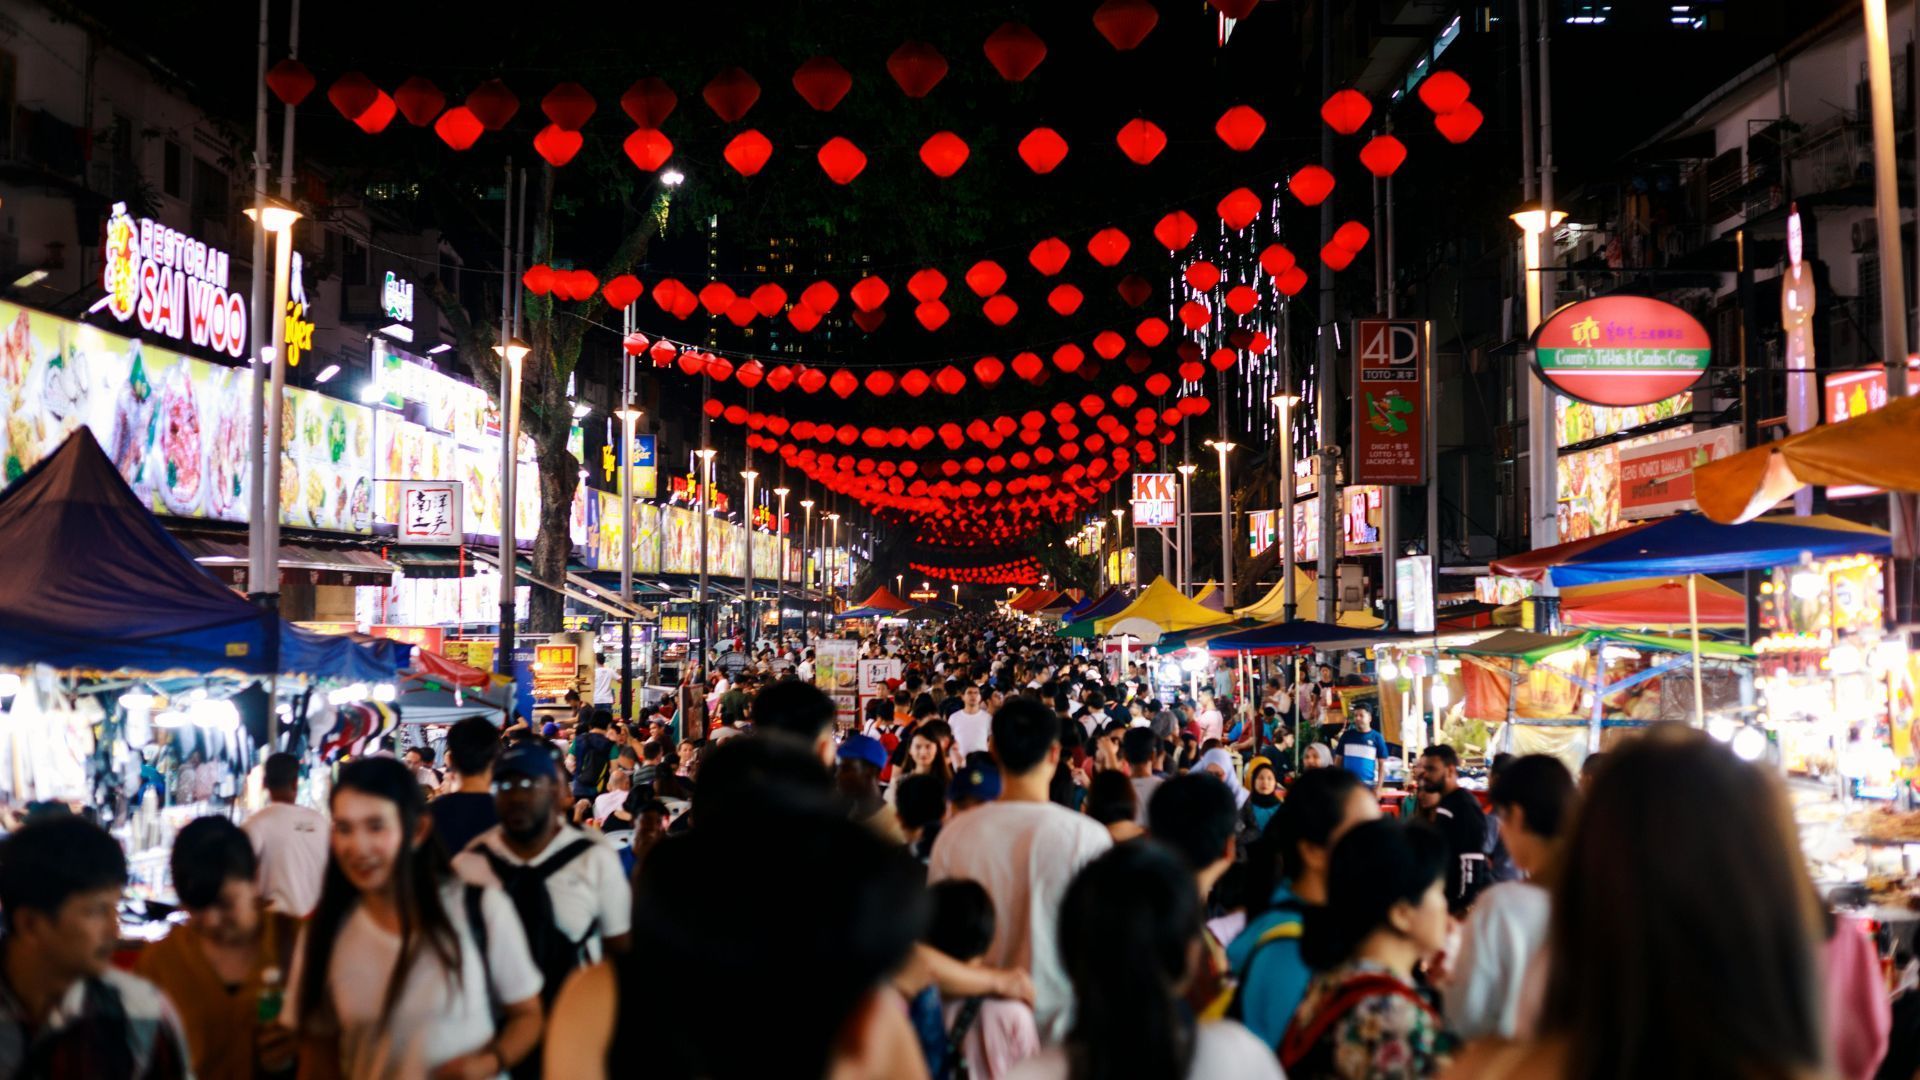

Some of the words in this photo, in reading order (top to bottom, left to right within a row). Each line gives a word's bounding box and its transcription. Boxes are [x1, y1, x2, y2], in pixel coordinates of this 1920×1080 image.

[140, 217, 230, 289] RESTORAN
[138, 258, 186, 340] SAI
[187, 275, 247, 358] WOO
[284, 300, 315, 367] iger
[1361, 326, 1418, 365] 4D
[1365, 370, 1391, 379] TOTO
[1555, 349, 1594, 368] Country's
[1635, 349, 1666, 366] Candies
[1668, 349, 1698, 369] Cottage
[1136, 475, 1171, 500] KK
